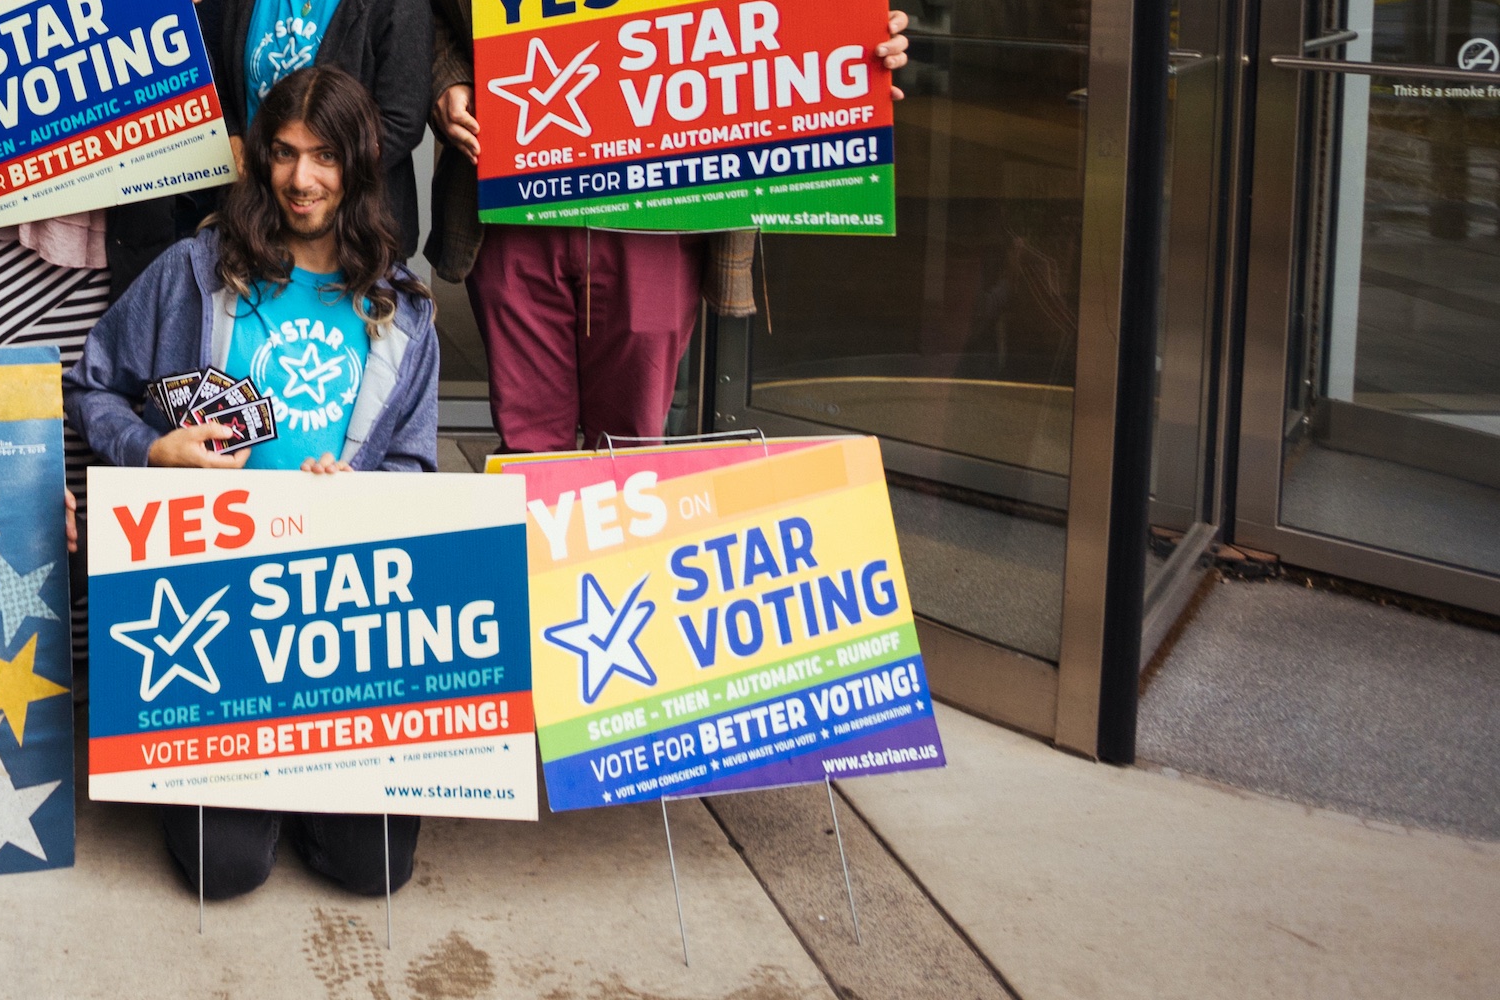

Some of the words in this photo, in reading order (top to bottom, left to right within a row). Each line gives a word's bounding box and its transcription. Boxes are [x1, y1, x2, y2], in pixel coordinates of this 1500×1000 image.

[618, 0, 780, 71] STAR
[30, 98, 120, 144] AUTOMATIC
[136, 67, 199, 106] RUNOFF
[619, 45, 869, 127] VOTING
[1393, 85, 1418, 96] This
[1421, 85, 1432, 96] is
[1435, 88, 1442, 96] a
[1445, 85, 1484, 97] smoke
[9, 138, 103, 188] BETTER
[106, 95, 212, 145] VOTING!
[33, 187, 53, 199] NEVER
[55, 180, 75, 192] WASTE
[77, 174, 94, 183] YOUR
[95, 166, 113, 176] VOTE!
[131, 156, 145, 164] FAIR
[147, 134, 205, 159] REPRESENTATION!
[515, 147, 573, 170] SCORE
[592, 137, 641, 159] THEN
[660, 119, 772, 151] AUTOMATIC
[792, 106, 874, 133] RUNOFF
[518, 176, 572, 200] VOTE
[579, 171, 620, 194] FOR
[628, 153, 740, 191] BETTER
[748, 136, 878, 177] VOTING!
[122, 164, 230, 195] www.starlane.us
[538, 211, 557, 219] VOTE
[558, 209, 579, 217] YOUR
[580, 203, 629, 215] CONSCIENCE!
[647, 196, 672, 208] NEVER
[675, 195, 700, 204] WASTE
[702, 192, 724, 201] YOUR
[725, 189, 748, 199] VOTE!
[770, 185, 788, 194] FAIR
[789, 177, 863, 191] REPRESENTATION!
[752, 212, 883, 225] www.starlane.us
[280, 318, 343, 350] STAR
[113, 490, 255, 561] YES
[271, 515, 303, 538] ON
[527, 471, 667, 562] YES
[679, 492, 711, 520] ON
[249, 547, 413, 620] STAR
[669, 516, 817, 601] STAR
[250, 600, 499, 683] VOTING
[677, 559, 898, 669] VOTING
[139, 702, 200, 728] SCORE
[220, 694, 272, 717] THEN
[293, 679, 404, 710] AUTOMATIC
[425, 667, 504, 692] RUNOFF
[588, 707, 646, 741] SCORE
[661, 691, 710, 719] THEN
[727, 660, 823, 700] AUTOMATIC
[837, 633, 899, 668] RUNOFF
[141, 739, 199, 765] VOTE
[207, 734, 250, 758] FOR
[257, 716, 374, 756] BETTER
[381, 700, 509, 742] VOTING!
[591, 746, 649, 782] VOTE
[653, 733, 695, 766] FOR
[699, 702, 807, 754] BETTER
[808, 664, 920, 722] VOTING!
[615, 784, 636, 798] VOTE
[636, 778, 658, 792] YOUR
[658, 765, 707, 787] CONSCIENCE!
[722, 752, 747, 768] NEVER
[748, 744, 773, 761] WASTE
[774, 739, 795, 752] YOUR
[795, 733, 817, 747] VOTE!
[834, 722, 850, 735] FAIR
[851, 704, 912, 730] REPRESENTATION!
[278, 766, 303, 775] NEVER
[306, 764, 331, 772] WASTE
[336, 760, 356, 769] YOUR
[359, 758, 381, 767] VOTE!
[404, 754, 420, 762] FAIR
[423, 746, 494, 760] REPRESENTATION!
[385, 785, 515, 799] www.starlane.us
[822, 744, 938, 773] www.starlane.us
